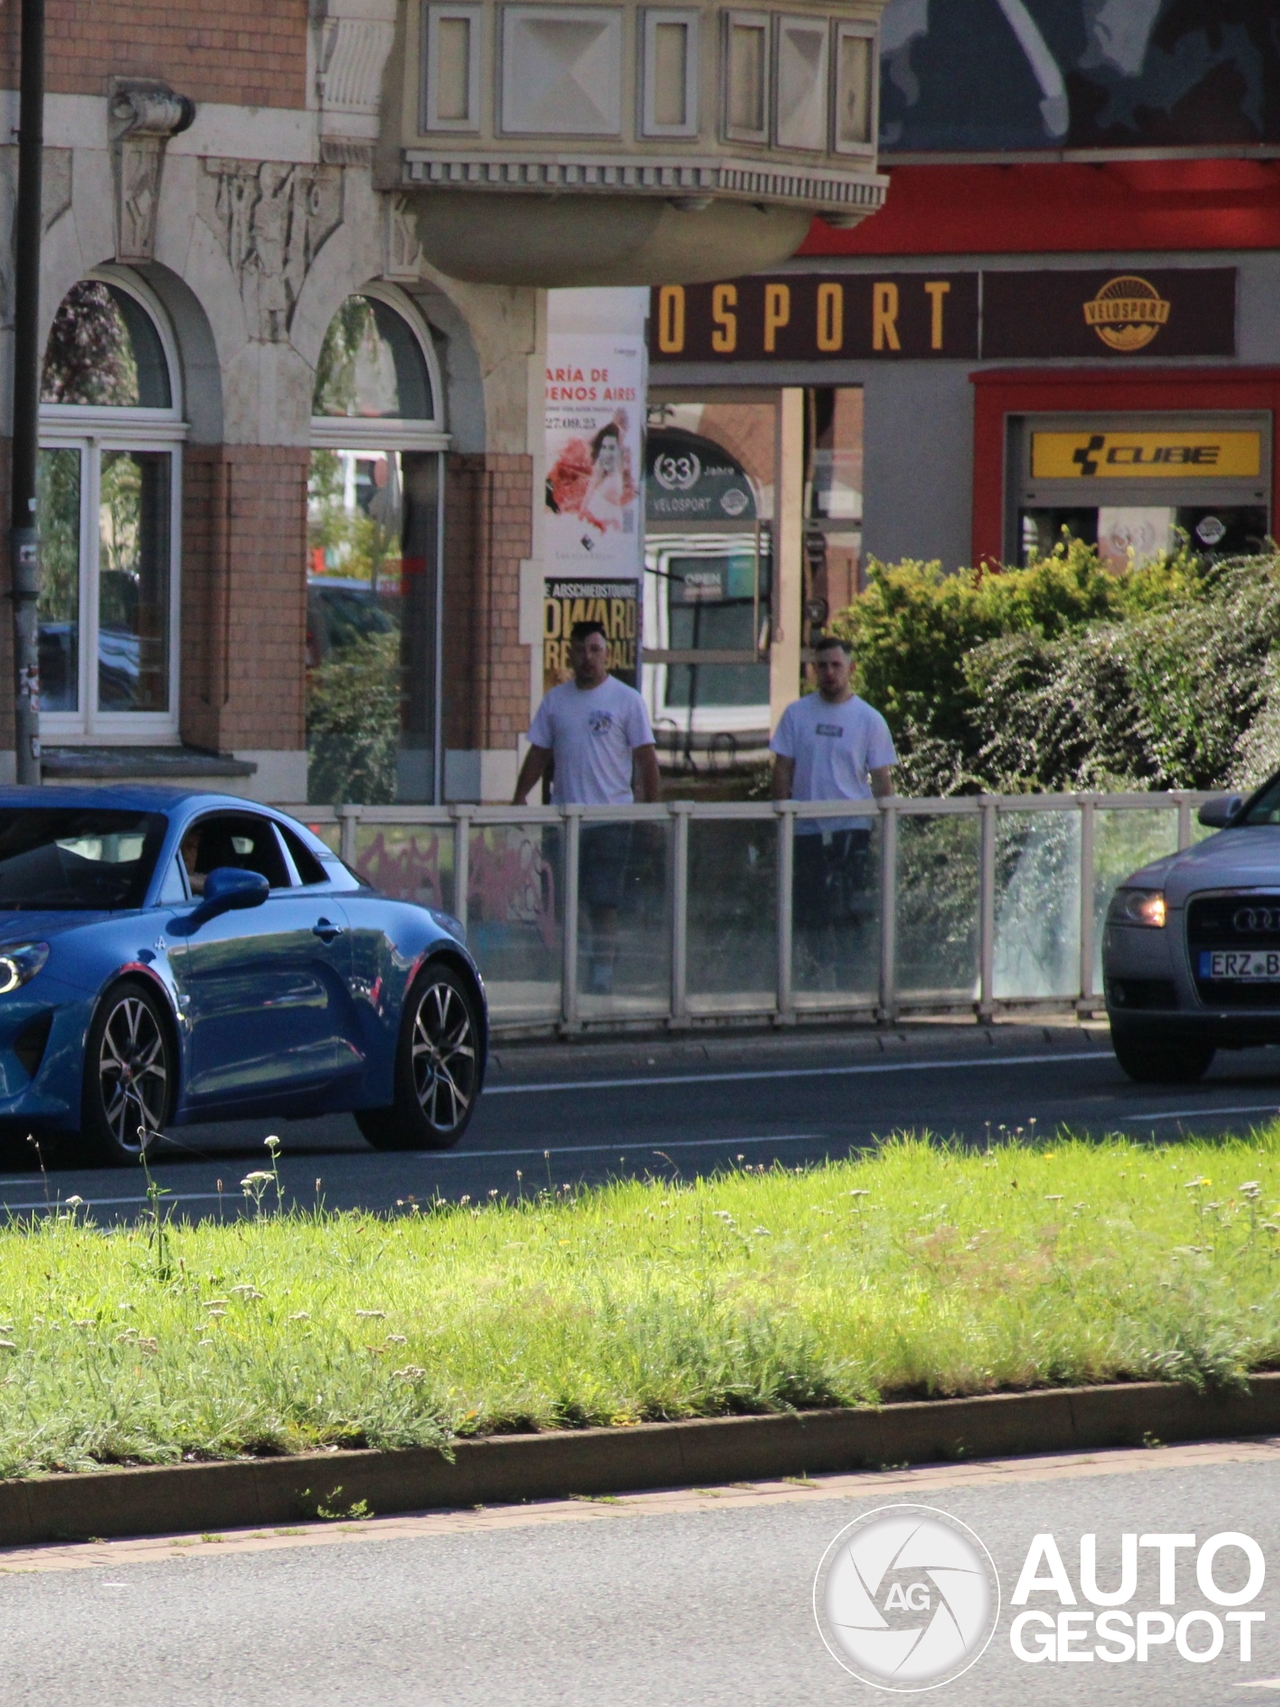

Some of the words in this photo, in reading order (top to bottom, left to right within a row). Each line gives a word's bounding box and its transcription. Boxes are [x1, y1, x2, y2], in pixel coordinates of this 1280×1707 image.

[658, 283, 951, 352] OSPORT
[1088, 302, 1167, 320] VELOSPORT
[591, 368, 608, 382] DE
[604, 387, 636, 401] AIRES
[1106, 446, 1221, 464] CUBE
[662, 457, 691, 481] 33
[654, 498, 711, 512] VELOSPORT
[1212, 954, 1251, 975] ERZ
[1266, 955, 1279, 974] B
